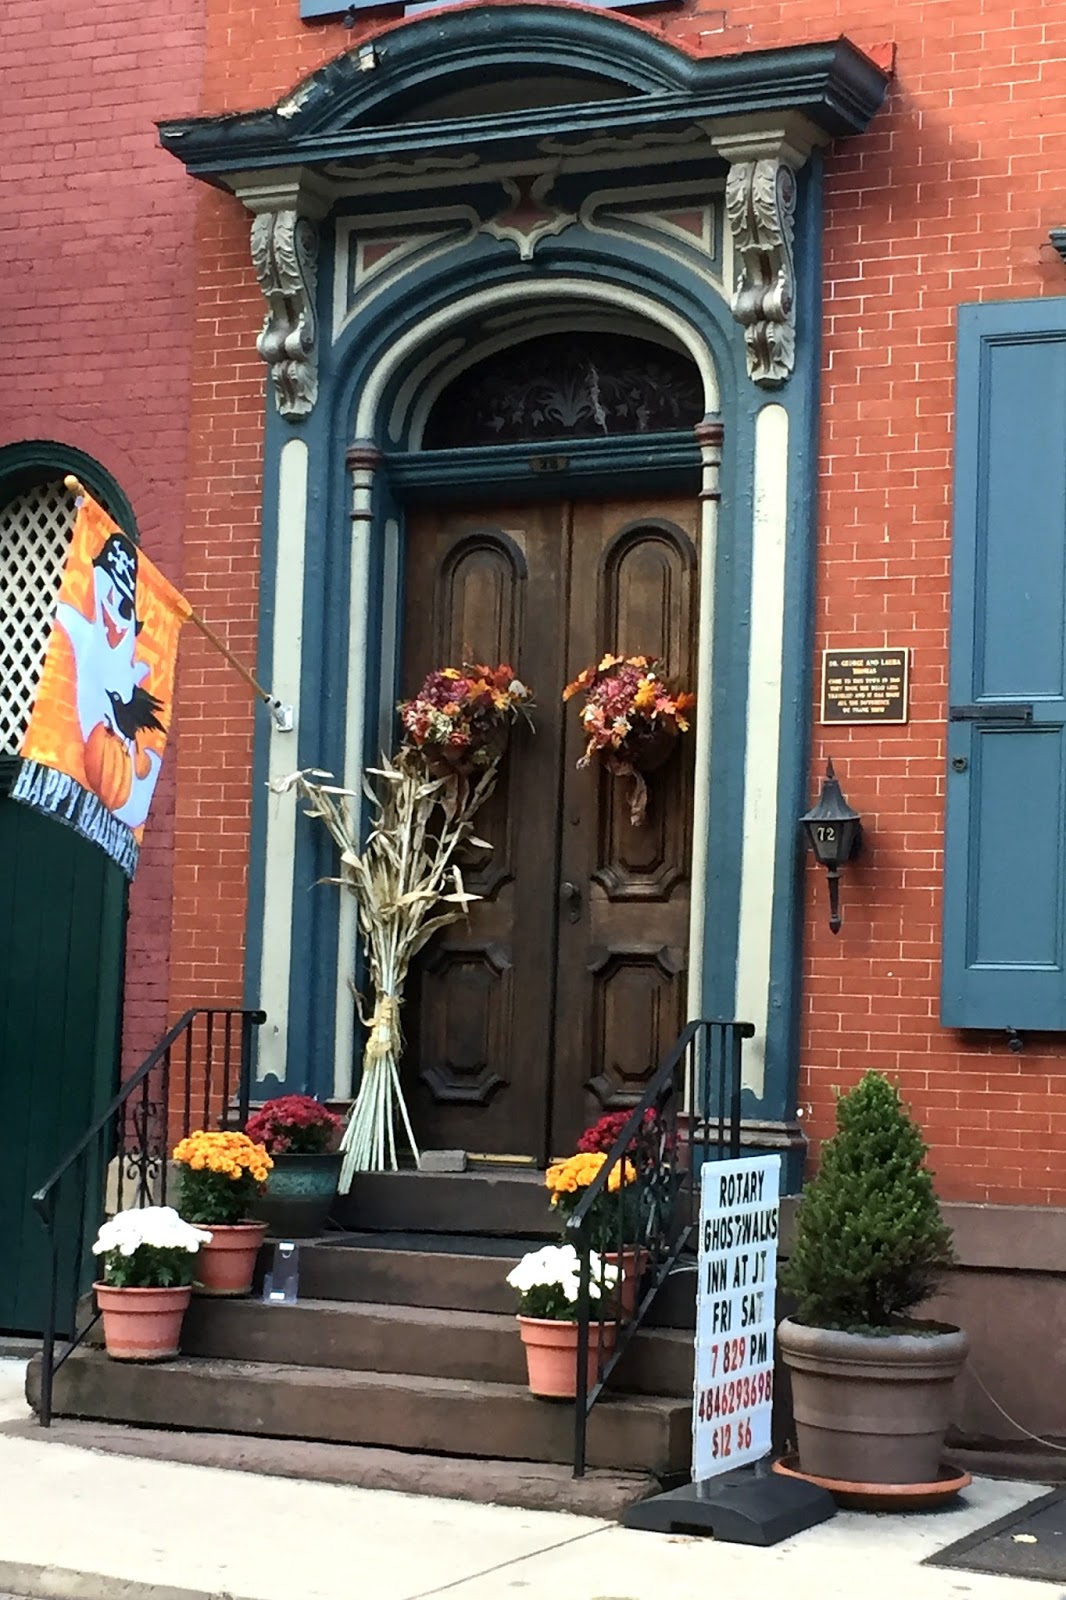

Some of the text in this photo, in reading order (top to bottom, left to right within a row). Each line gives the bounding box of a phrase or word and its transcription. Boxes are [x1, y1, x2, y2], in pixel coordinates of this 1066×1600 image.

[12, 758, 138, 880] HAPPY HALLOWE
[817, 827, 835, 841] 72
[719, 1170, 764, 1208] ROTARY
[707, 1250, 767, 1294] INN AT JT
[712, 1291, 764, 1335] FRI SAT
[711, 1344, 718, 1378] 7
[750, 1332, 767, 1367] PM
[698, 1370, 771, 1423] 4846293698
[712, 1416, 752, 1460] $12 $6
